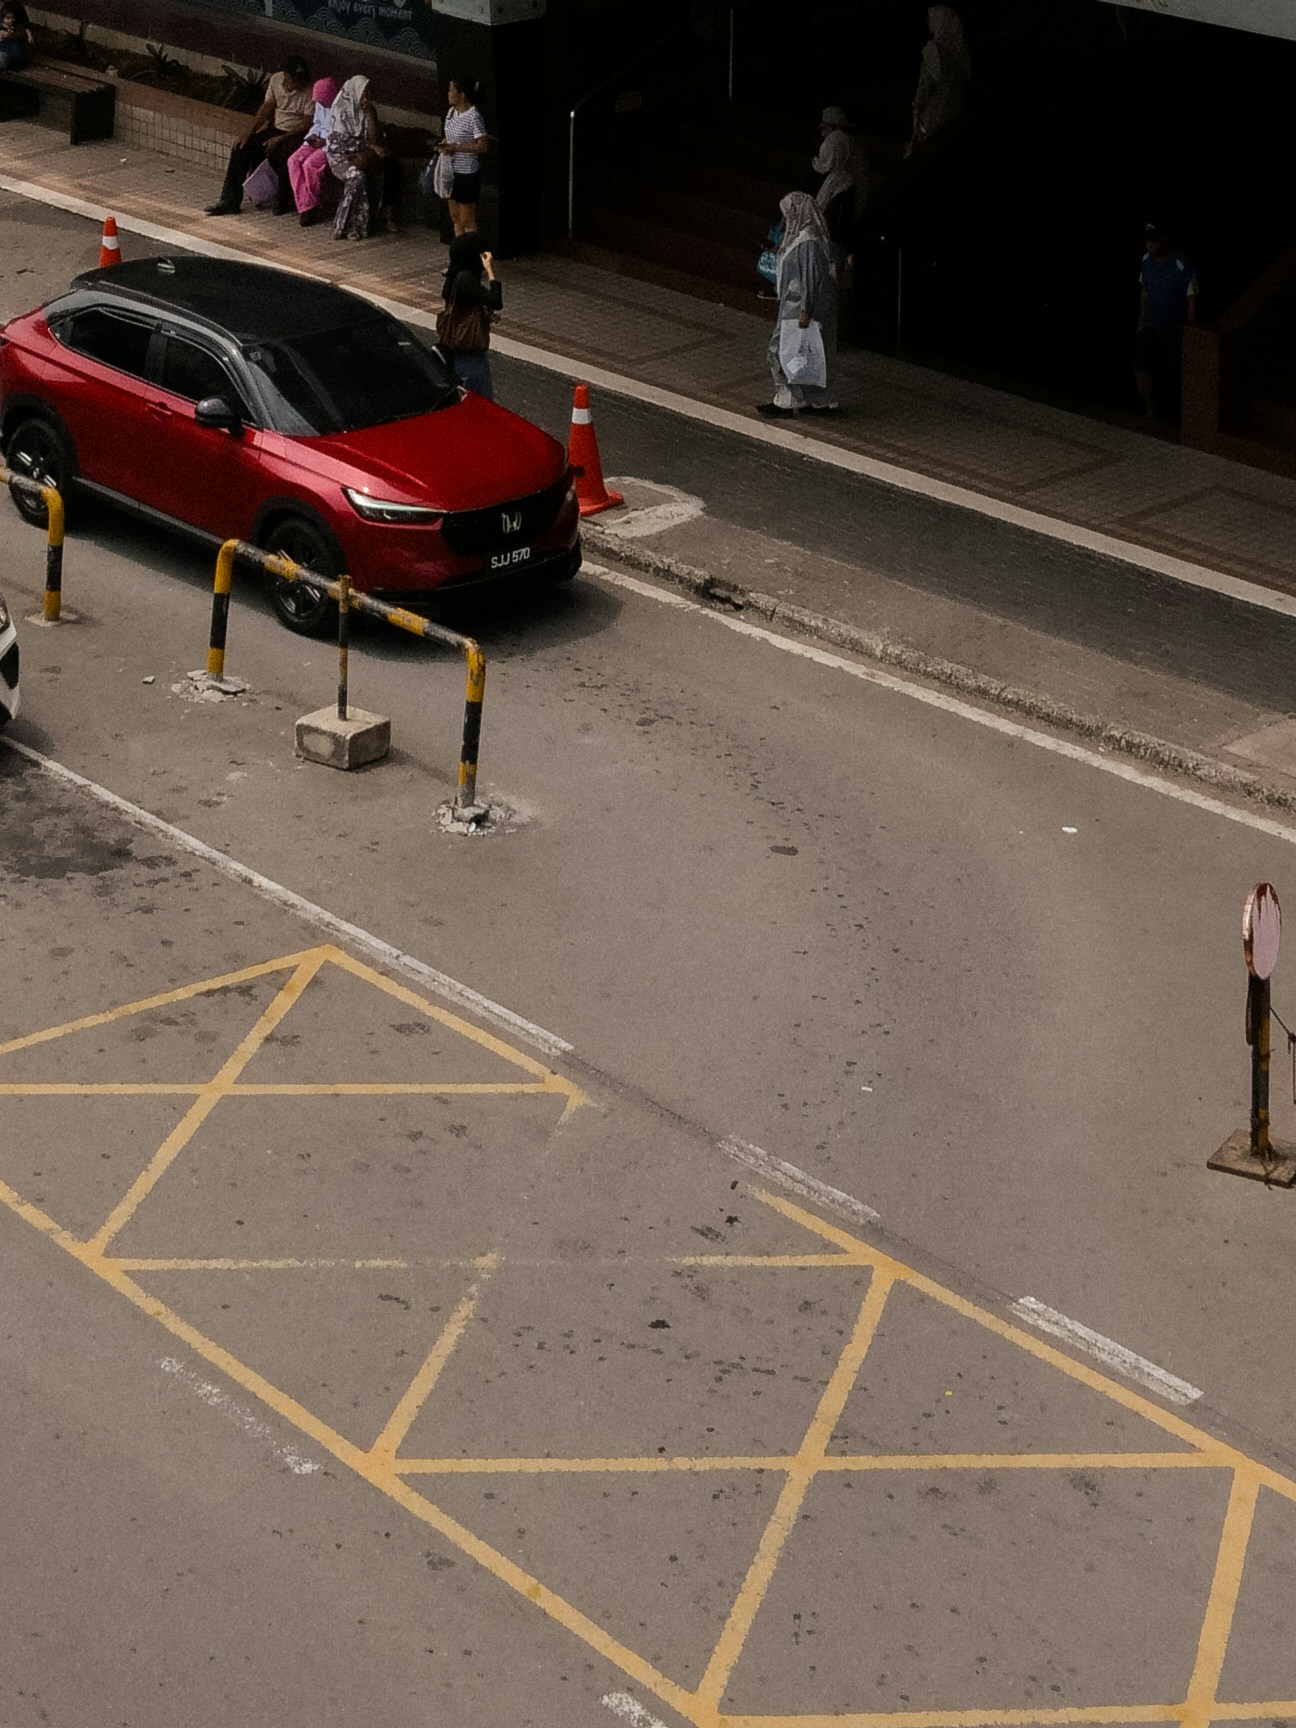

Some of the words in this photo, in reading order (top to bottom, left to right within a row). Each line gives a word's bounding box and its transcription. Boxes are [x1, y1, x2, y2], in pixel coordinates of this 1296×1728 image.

[353, 2, 375, 19] every
[378, 6, 413, 21] moment
[491, 552, 510, 568] SJJ
[512, 547, 530, 562] 570
